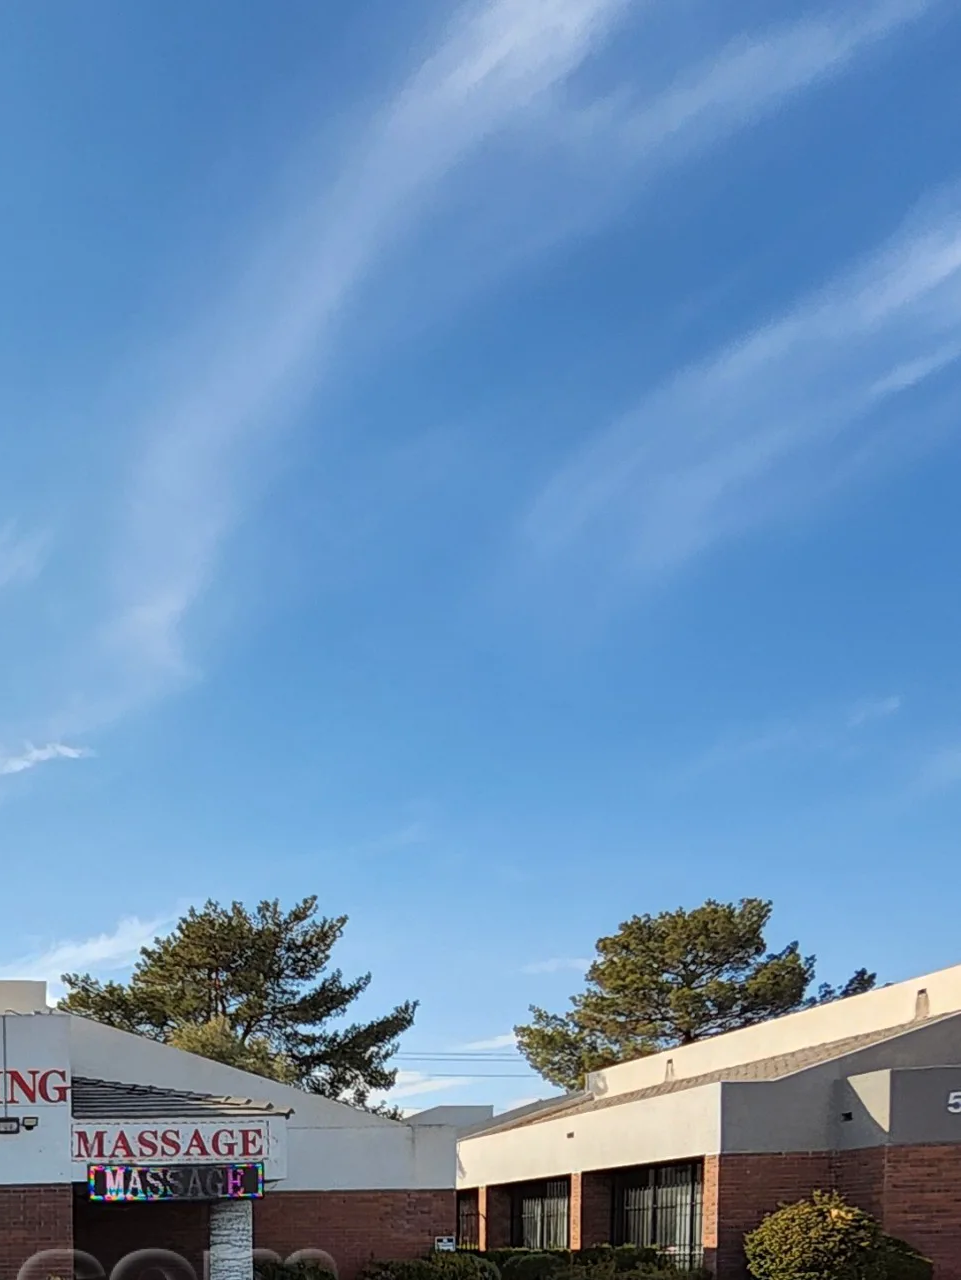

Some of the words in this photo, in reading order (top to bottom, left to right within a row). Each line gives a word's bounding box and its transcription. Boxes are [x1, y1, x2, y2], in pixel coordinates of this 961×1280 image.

[947, 1091, 961, 1113] 5
[74, 1128, 263, 1158] MASSAGE
[105, 1168, 245, 1198] MASSAGE
